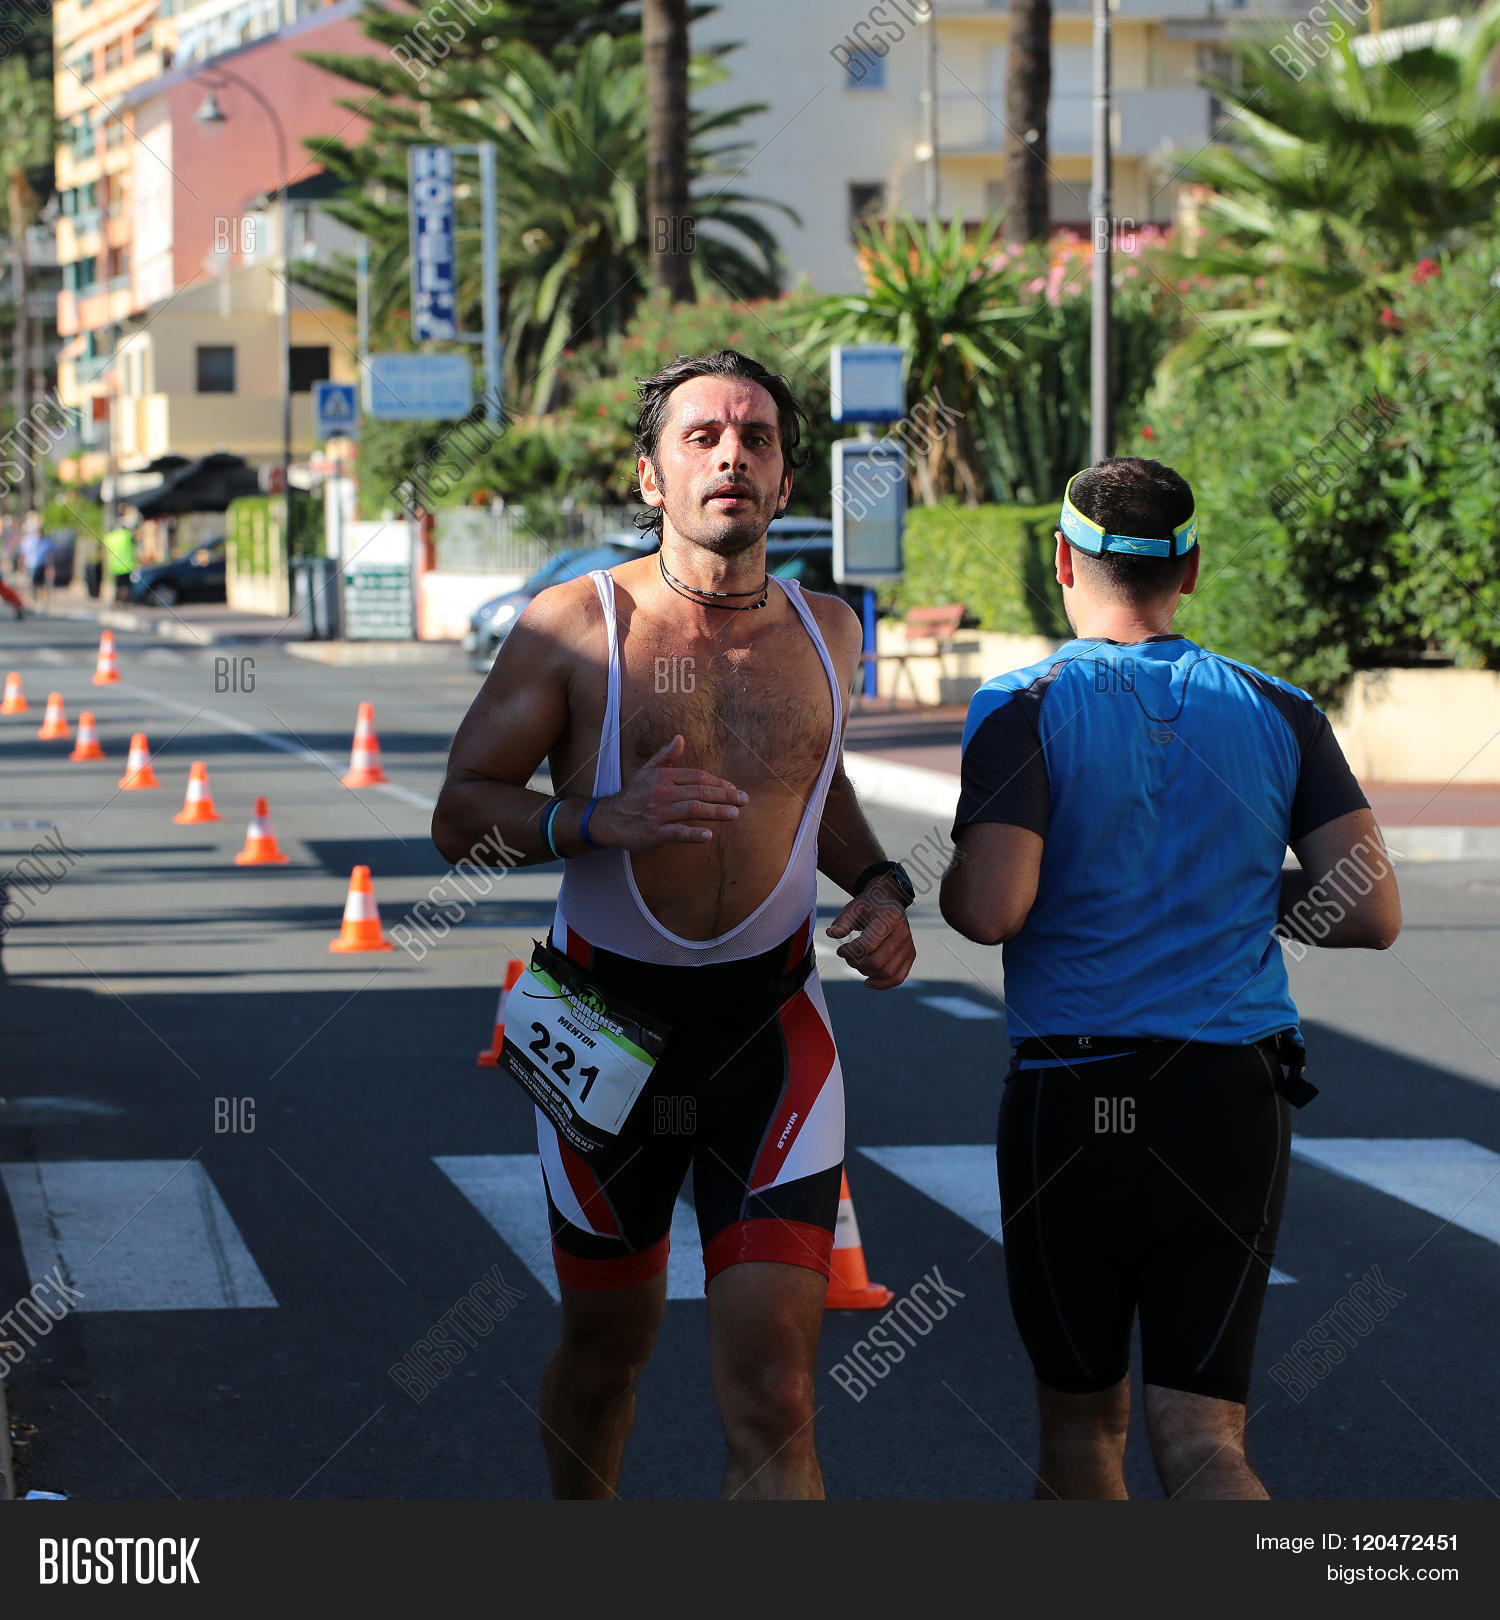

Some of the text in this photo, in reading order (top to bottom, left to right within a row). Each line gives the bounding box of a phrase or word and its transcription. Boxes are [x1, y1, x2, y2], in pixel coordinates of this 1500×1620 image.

[413, 146, 453, 292] HOTEL
[557, 1016, 597, 1050] MENTON
[571, 1006, 600, 1032] SHOP
[528, 1021, 600, 1104] 221
